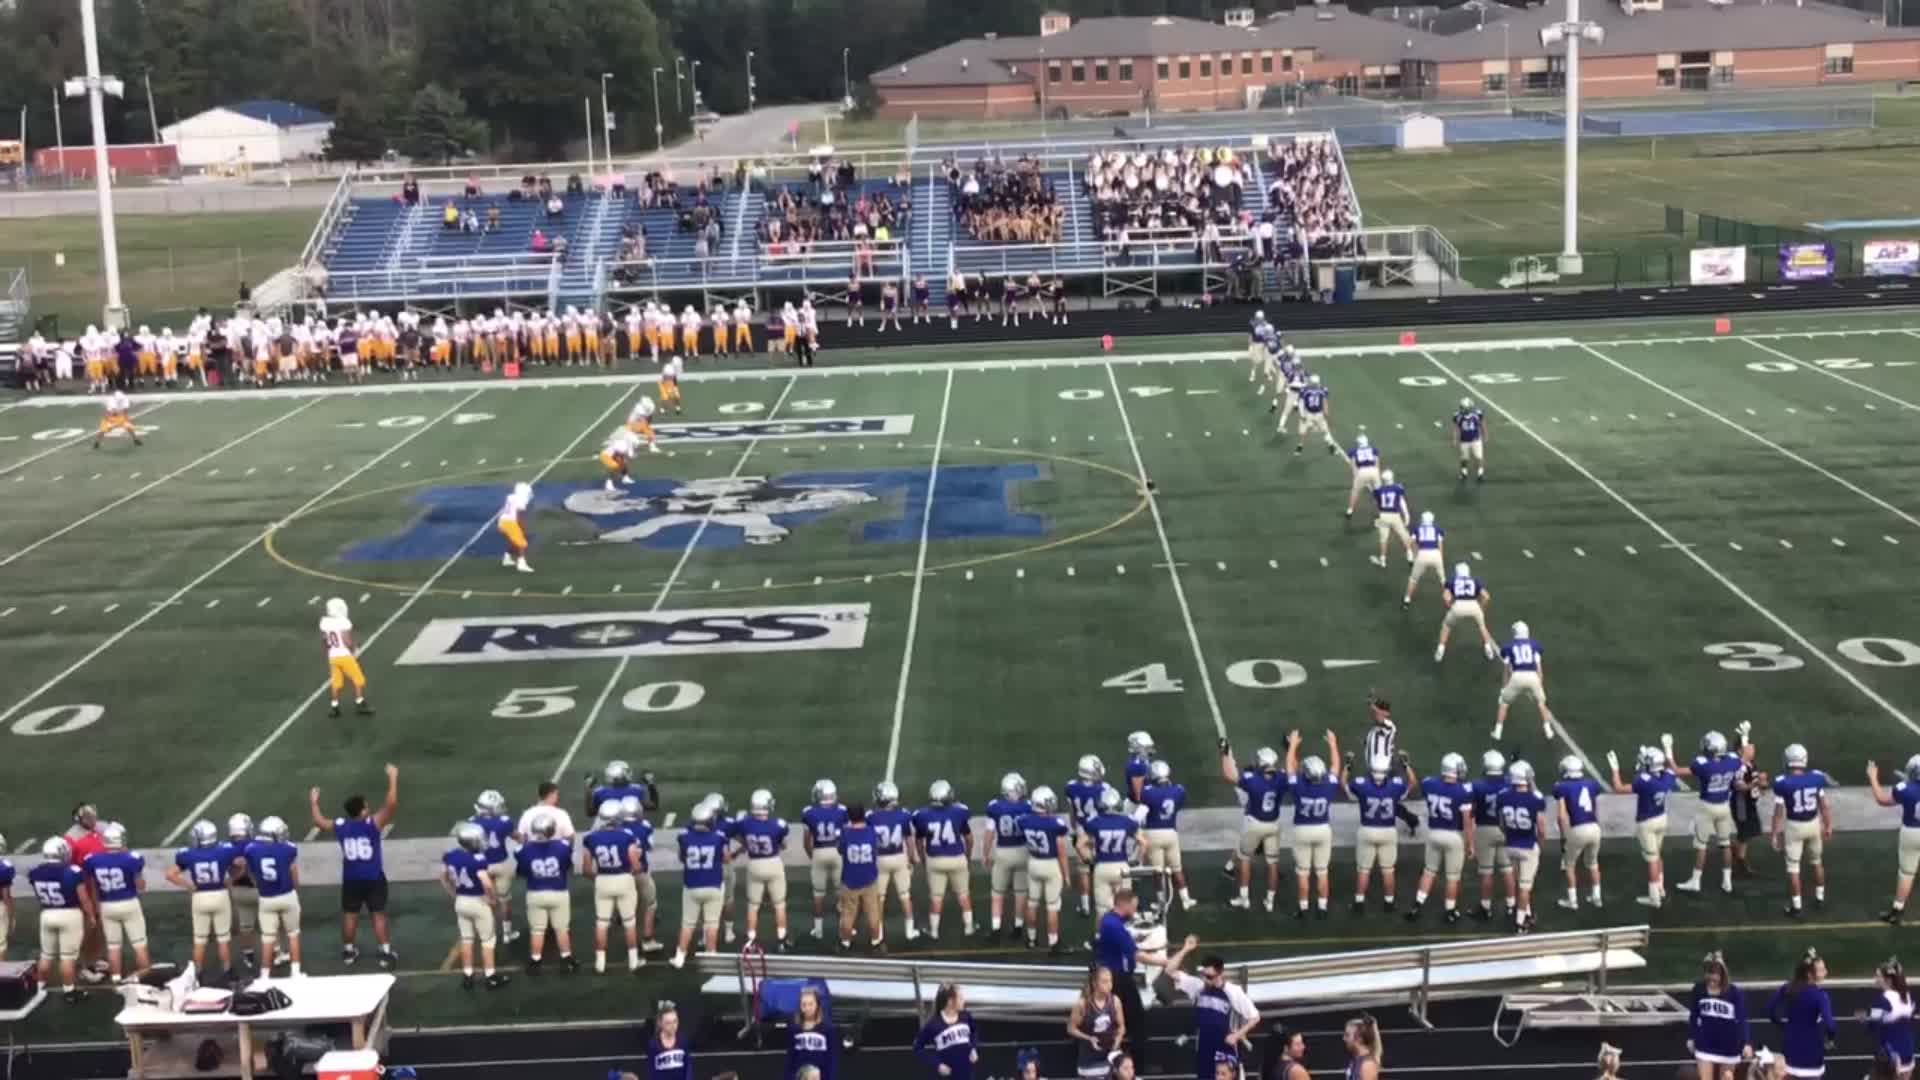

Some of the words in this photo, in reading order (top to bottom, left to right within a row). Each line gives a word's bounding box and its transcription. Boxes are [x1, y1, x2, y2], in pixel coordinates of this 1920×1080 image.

[1381, 491, 1397, 508] 17
[1453, 578, 1476, 597] 23
[442, 614, 831, 655] ROSS
[1512, 644, 1534, 665] 10
[1160, 799, 1175, 820] 3
[1261, 792, 1276, 812] 6
[1300, 797, 1328, 817] 70
[1365, 798, 1394, 819] 73
[1427, 795, 1453, 820] 75
[1578, 786, 1592, 812] 4
[1793, 789, 1819, 813] 15
[817, 822, 836, 842] 11
[927, 821, 956, 845] 74
[1024, 829, 1050, 854] 53
[1099, 829, 1126, 853] 77
[595, 845, 622, 867] 21
[687, 845, 715, 869] 27
[95, 868, 127, 891] 52
[194, 861, 220, 884] 51
[260, 858, 278, 882] 5
[34, 881, 65, 906] 55
